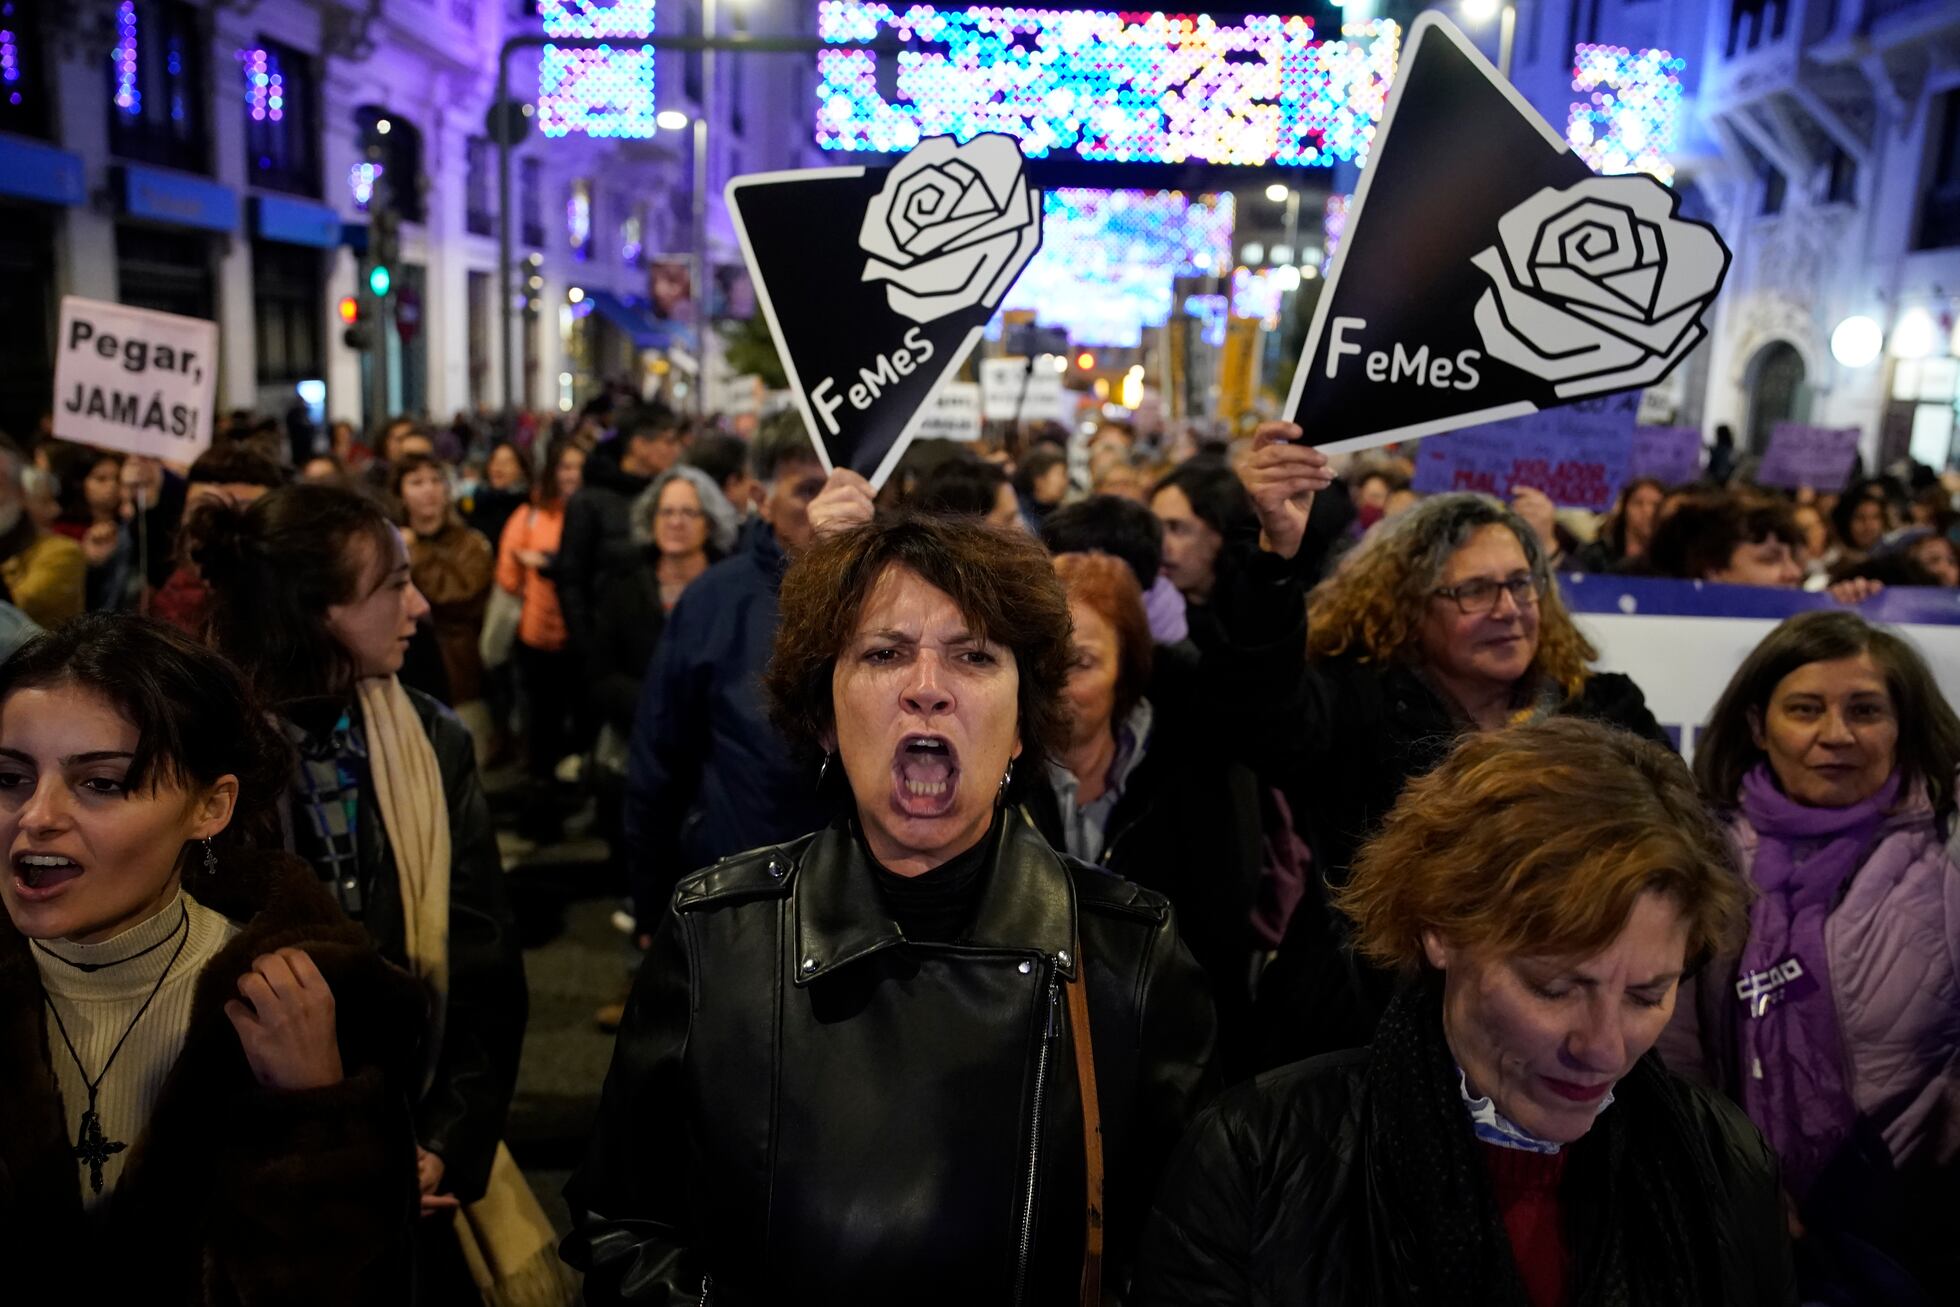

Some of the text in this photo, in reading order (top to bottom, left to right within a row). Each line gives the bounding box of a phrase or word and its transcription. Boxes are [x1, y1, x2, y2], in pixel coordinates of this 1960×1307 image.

[68, 320, 202, 384] Pegar,
[810, 326, 935, 436] FeMeS
[1325, 316, 1482, 391] FeMeS
[65, 382, 198, 441] JAMÁS!
